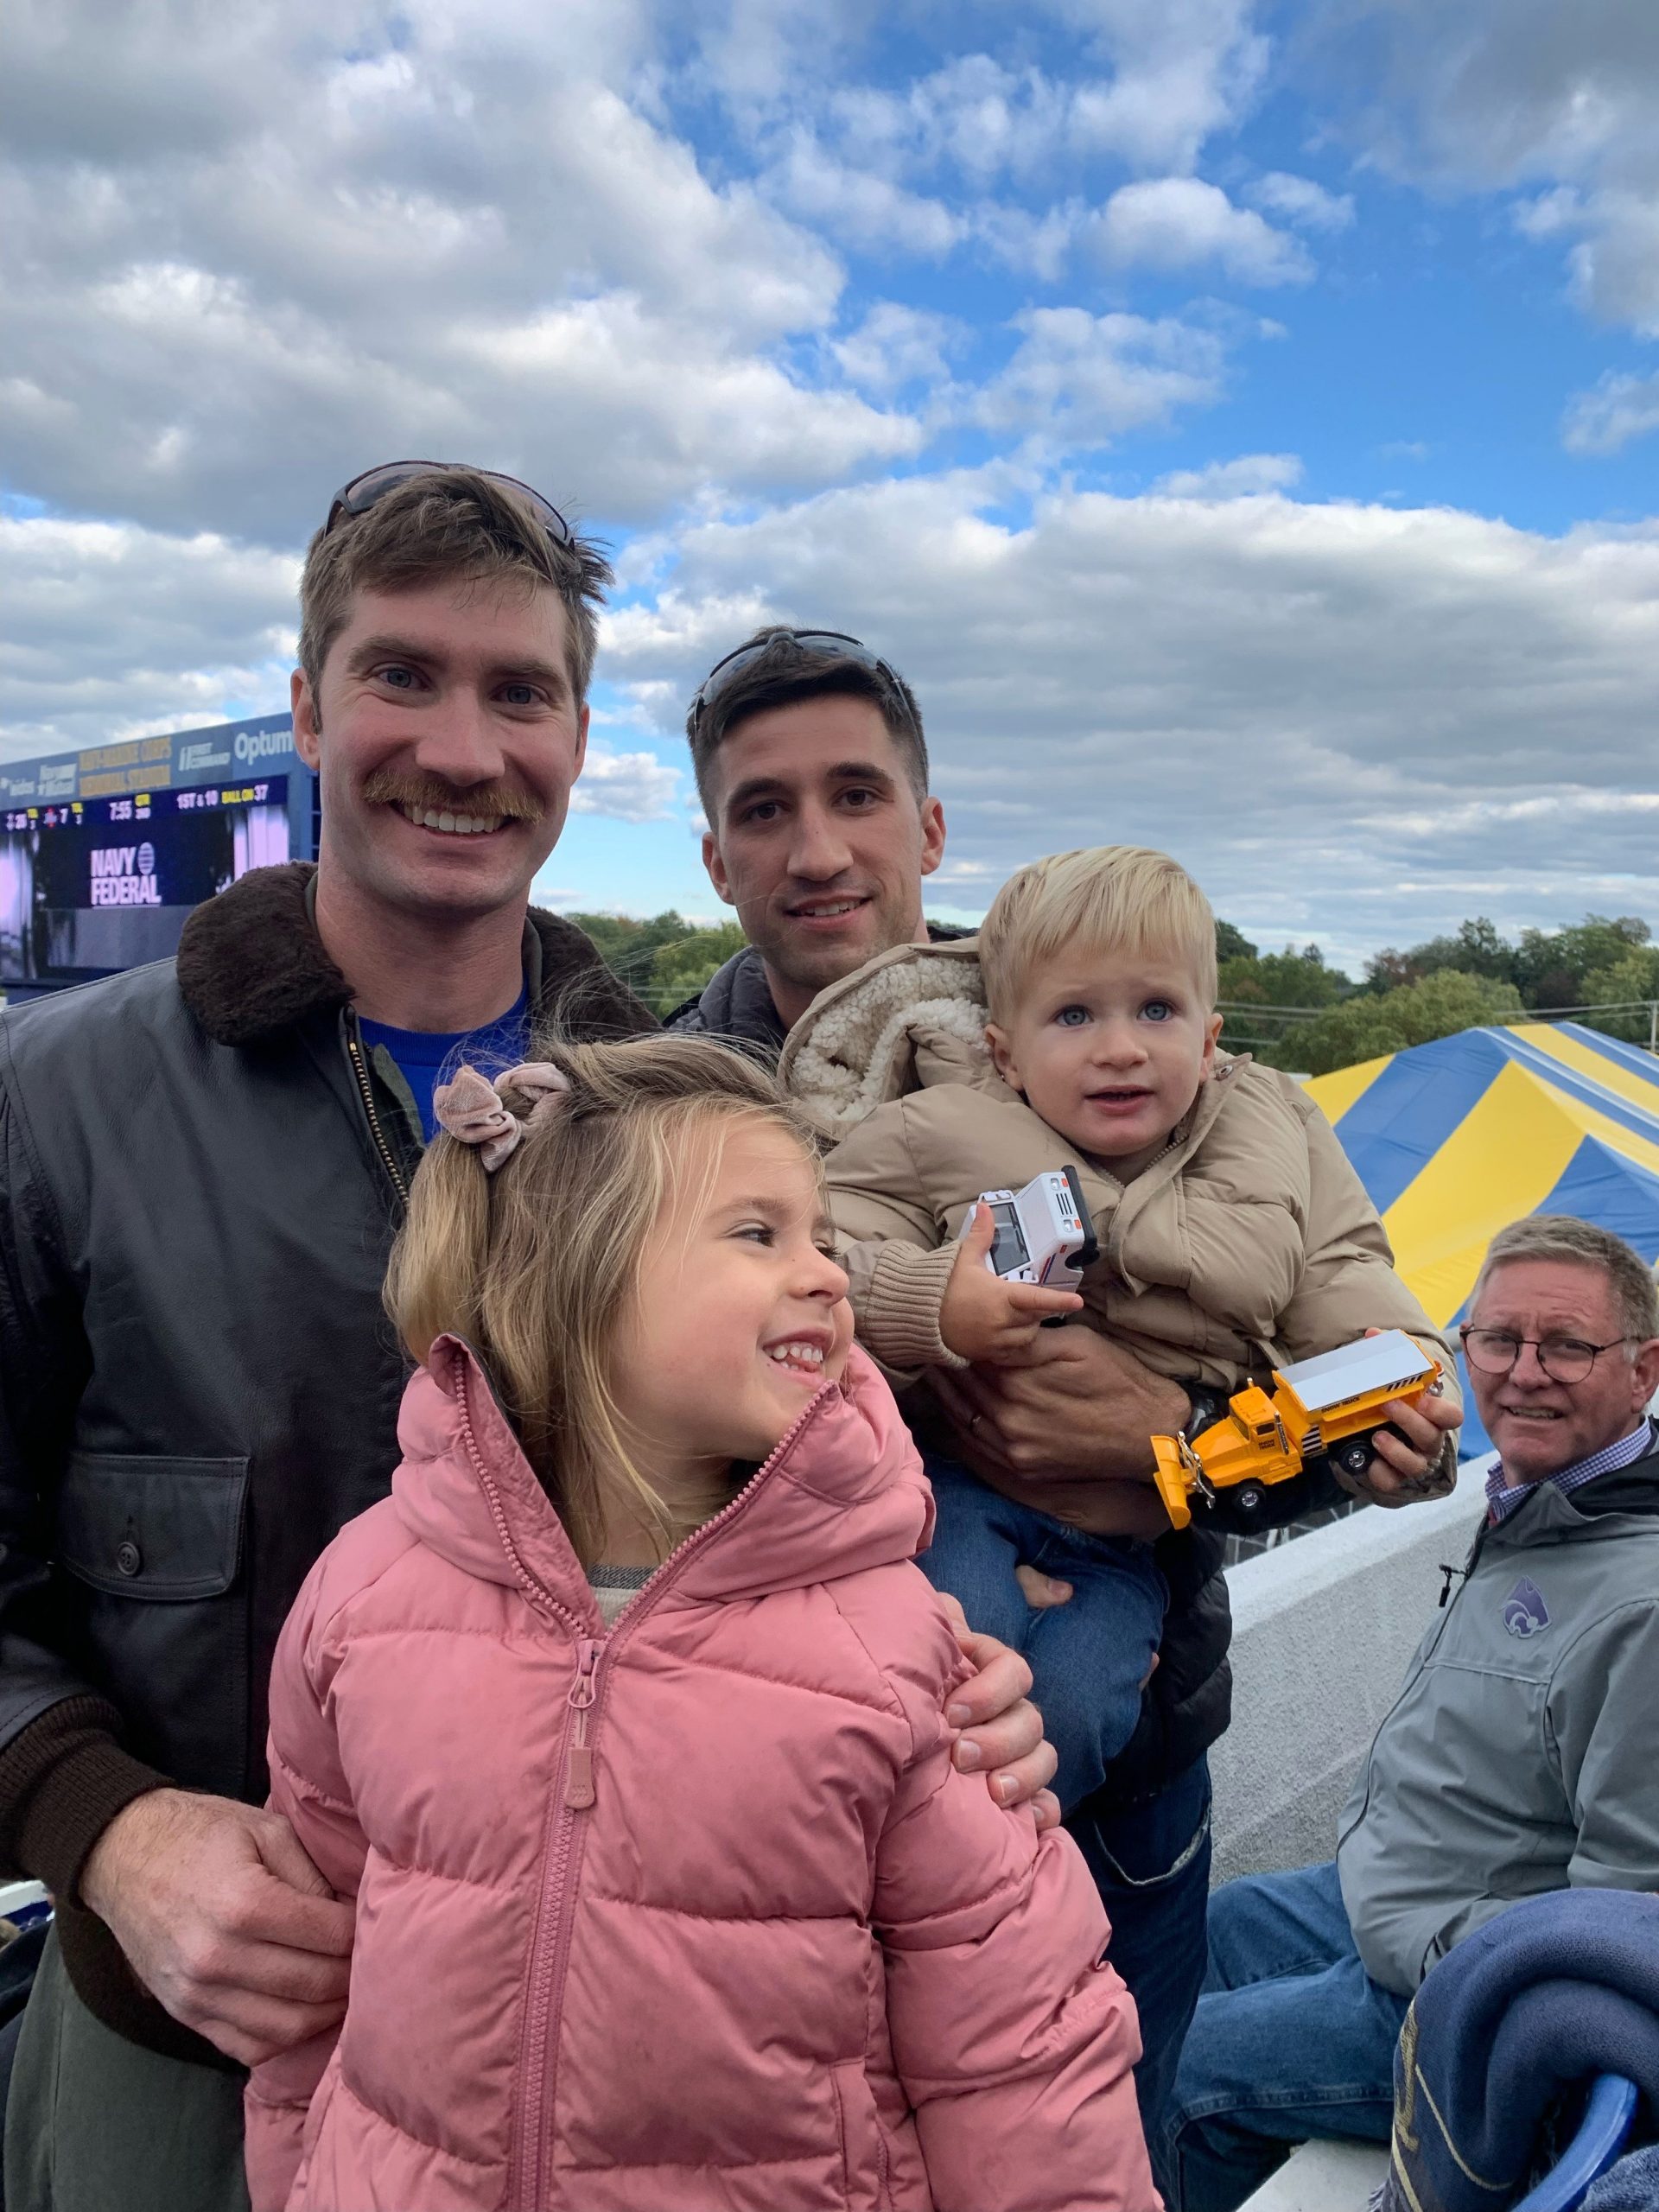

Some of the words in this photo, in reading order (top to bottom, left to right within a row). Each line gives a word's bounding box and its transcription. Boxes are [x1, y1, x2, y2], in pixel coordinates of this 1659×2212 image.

[234, 729, 294, 766] Optum
[176, 792, 196, 810] 1ST
[205, 790, 218, 806] 10
[221, 790, 241, 804] BALL
[241, 788, 254, 802] ON
[254, 784, 269, 802] 37
[59, 808, 68, 824] 7
[91, 846, 137, 878] NAVY
[91, 874, 162, 906] FEDERAL
[1342, 1396, 1360, 1406] TRUCK
